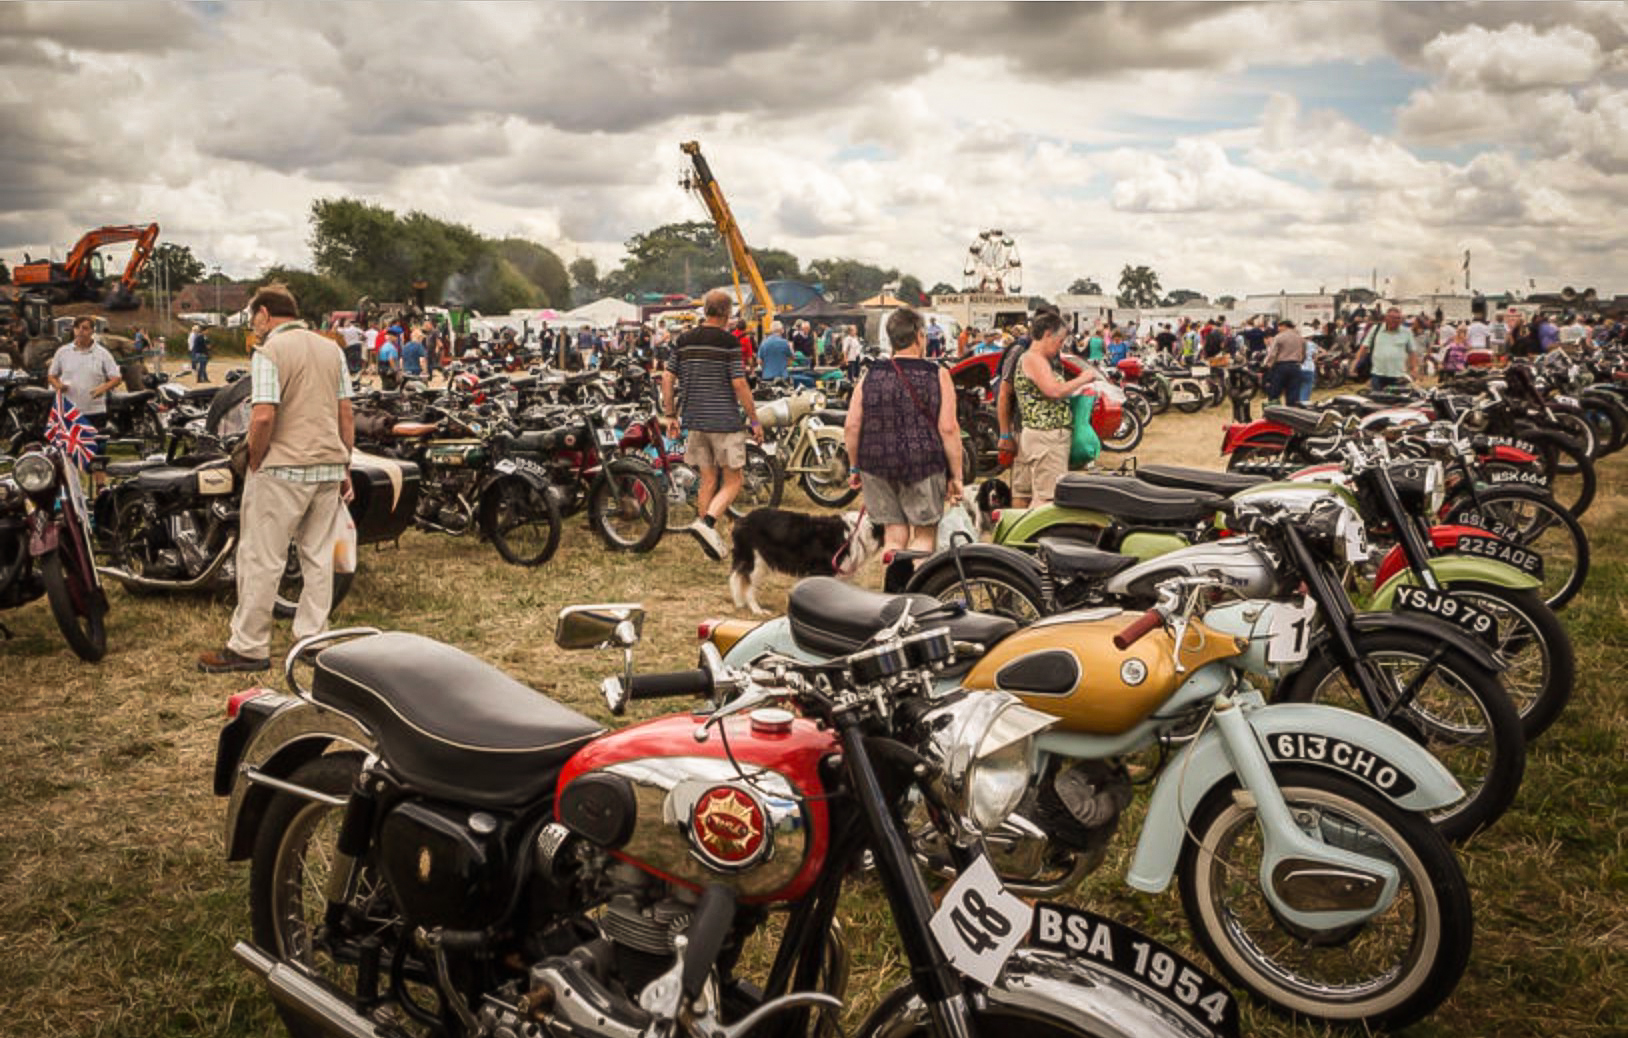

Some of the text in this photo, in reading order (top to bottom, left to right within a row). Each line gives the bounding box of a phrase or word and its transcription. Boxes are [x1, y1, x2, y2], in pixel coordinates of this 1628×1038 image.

[1277, 734, 1398, 789] 613CHO
[949, 888, 1012, 956] 48
[1038, 907, 1229, 1025] BSA 1954
